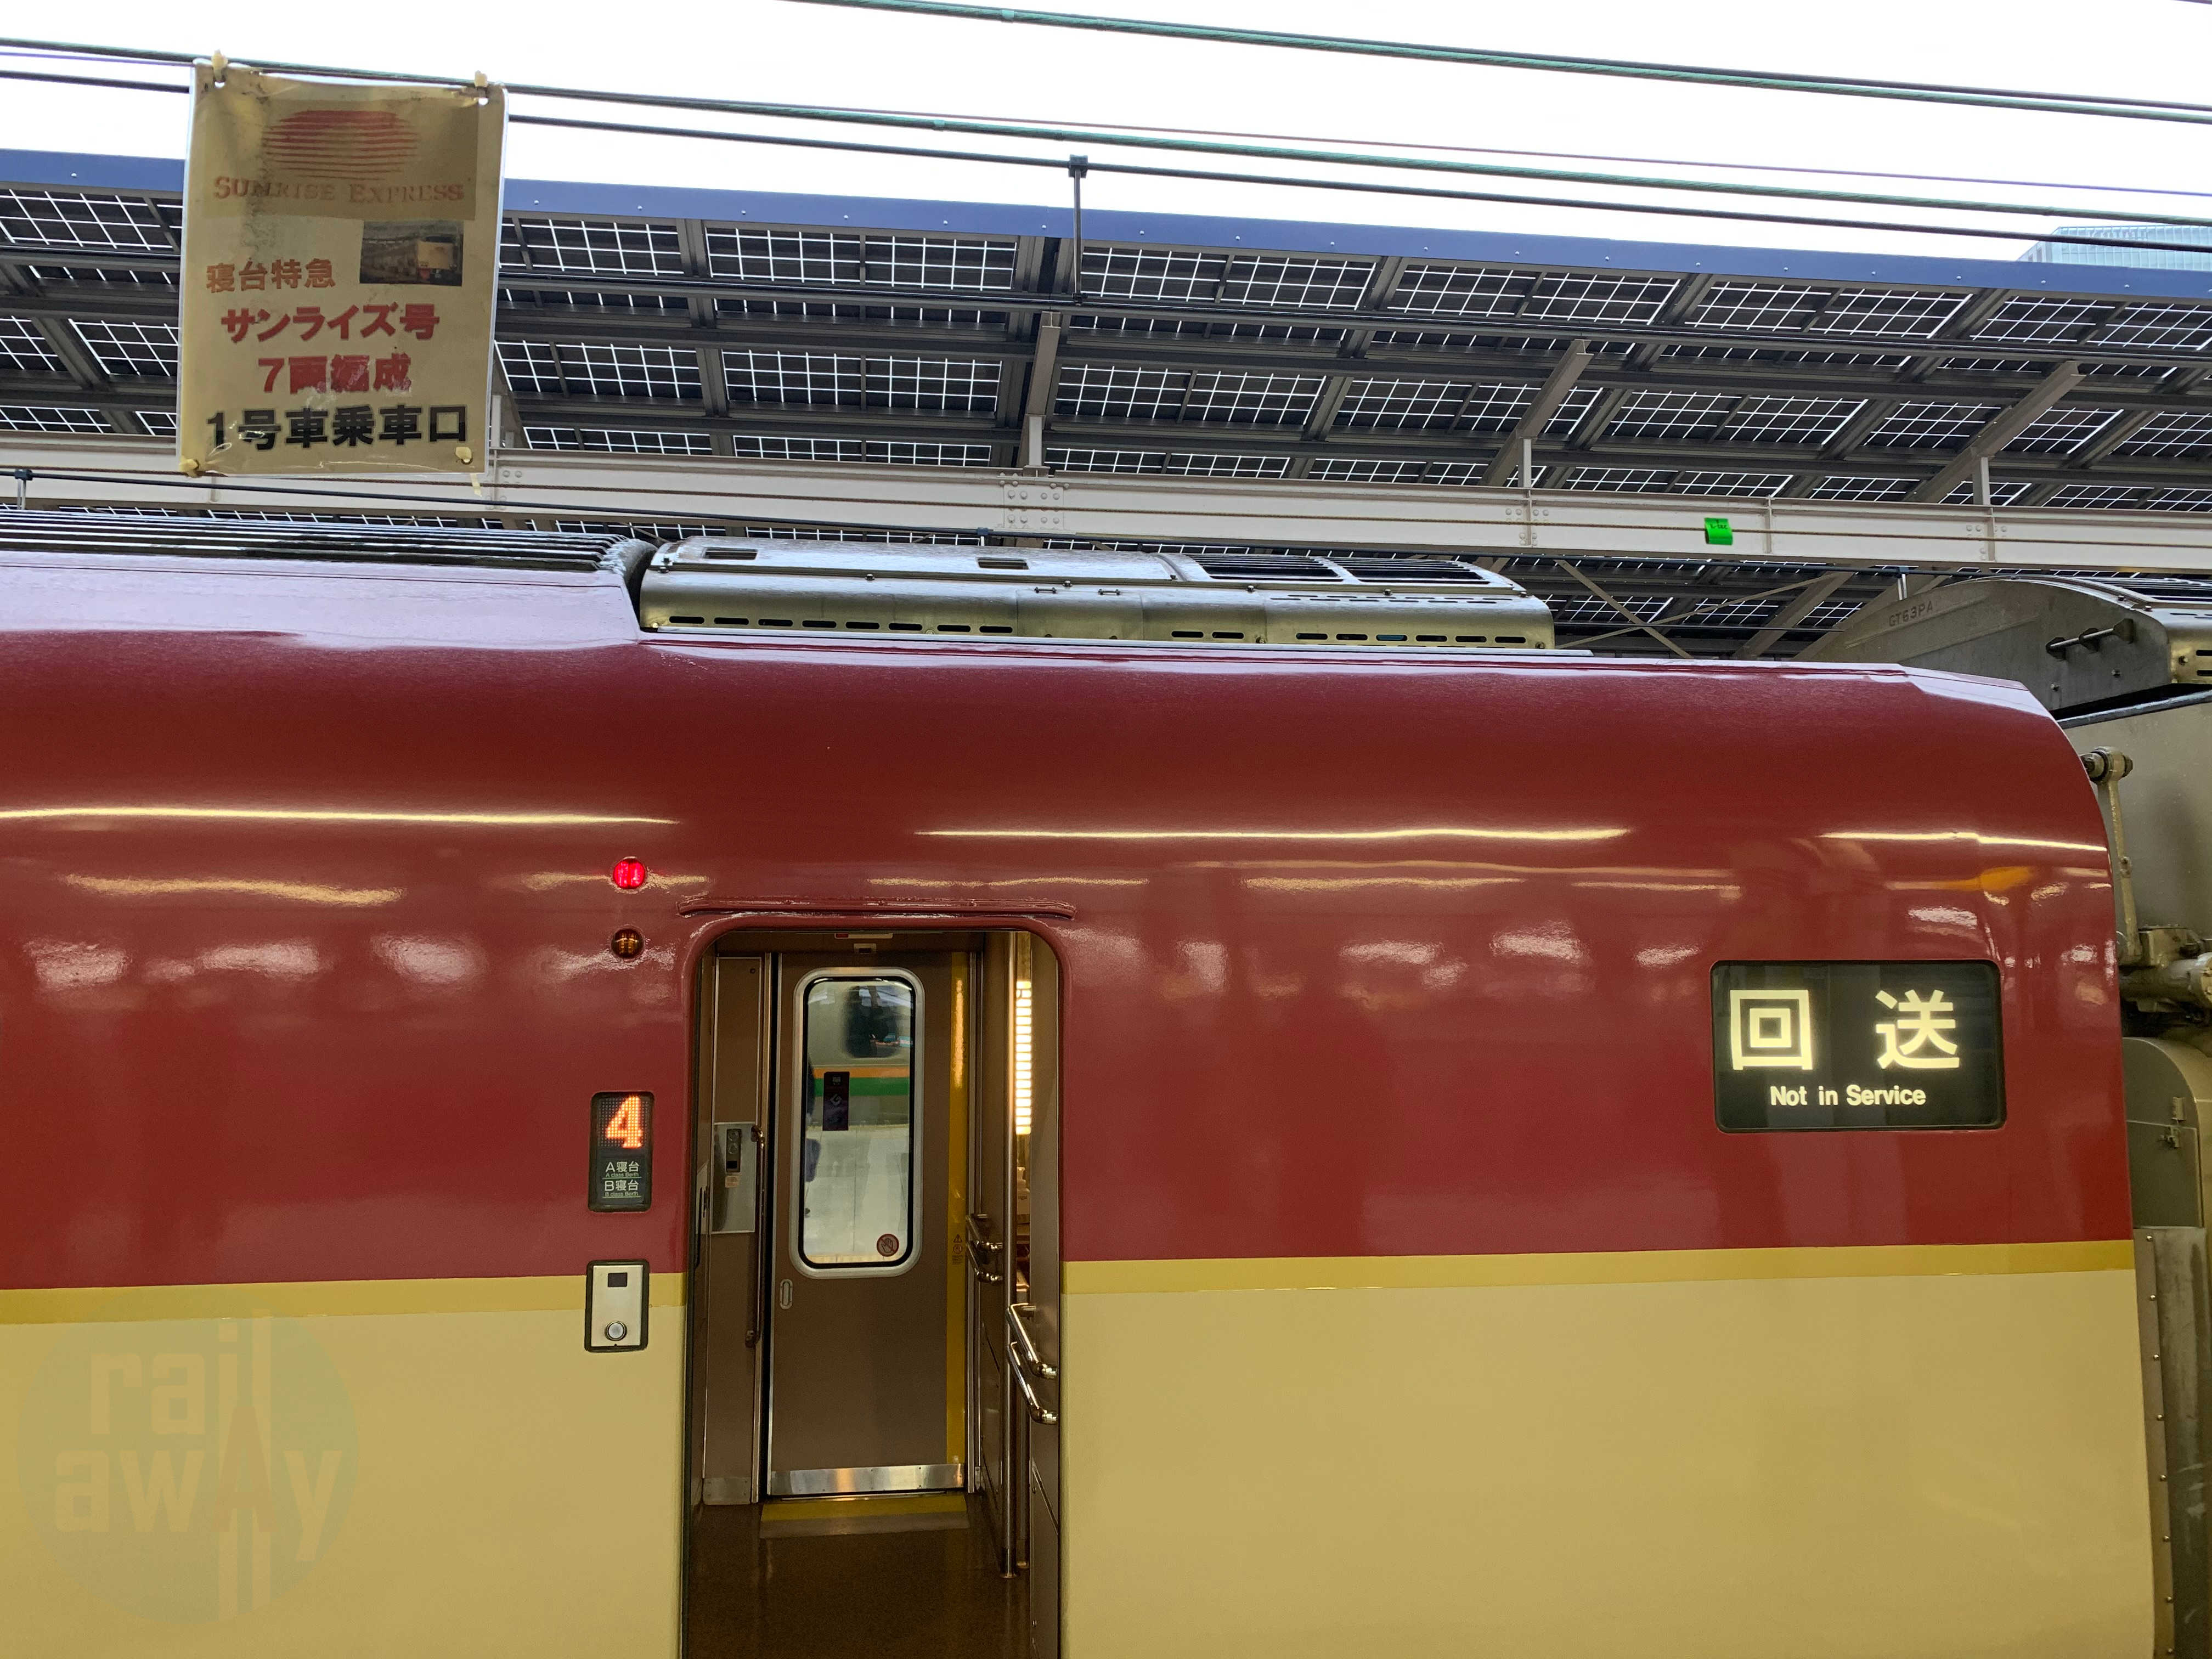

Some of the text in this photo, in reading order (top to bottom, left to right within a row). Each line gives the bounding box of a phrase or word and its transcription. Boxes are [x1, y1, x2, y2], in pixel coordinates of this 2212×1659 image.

[213, 174, 465, 203] SUNRISE EXPRESS
[206, 257, 336, 294] 寝台特急
[221, 301, 440, 343] サンライズ号
[206, 404, 468, 451] 1号車乗車口
[1729, 989, 1960, 1071] 回送
[1770, 1084, 1927, 1106] Not in Service
[606, 1096, 642, 1149] 4
[605, 1160, 640, 1172] A寝台
[604, 1179, 639, 1191] B寝台
